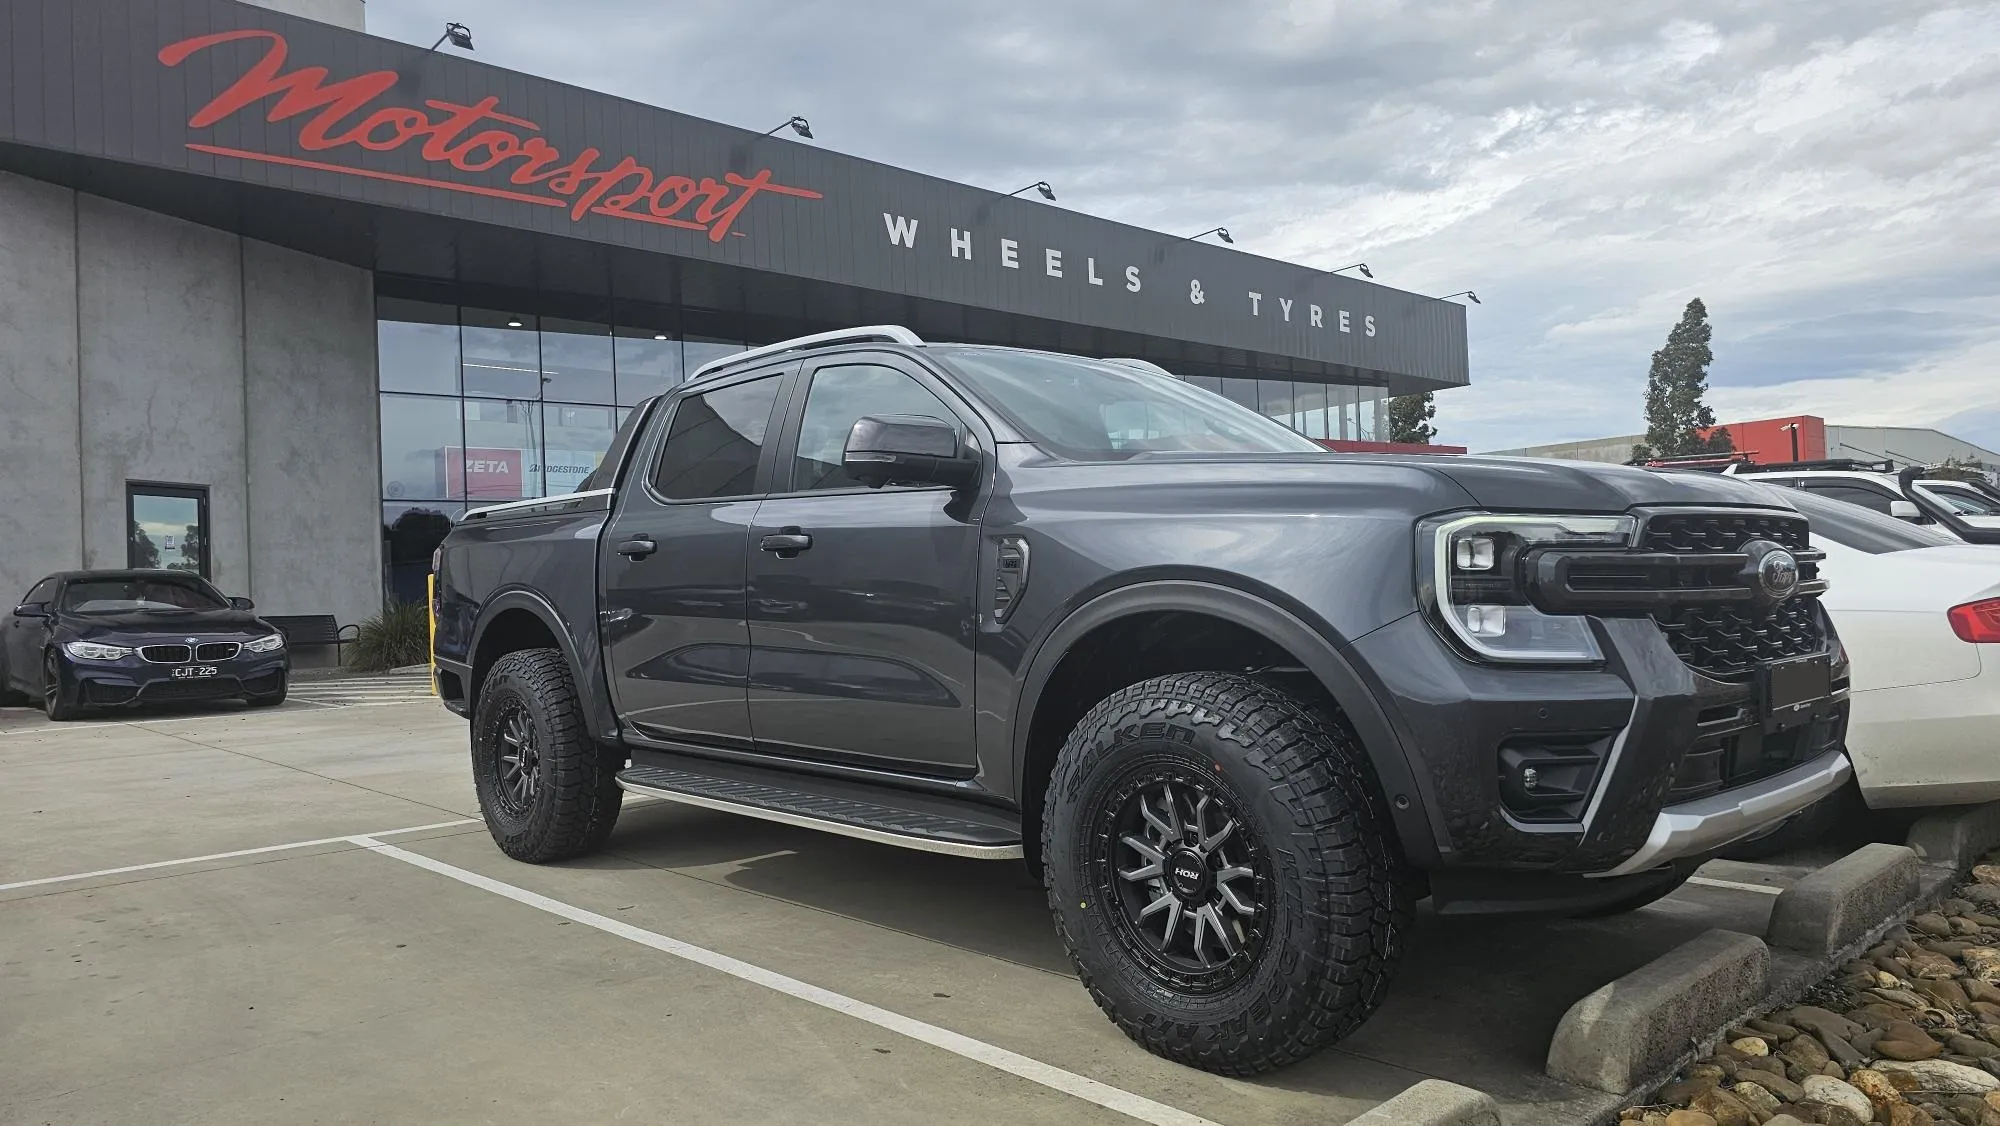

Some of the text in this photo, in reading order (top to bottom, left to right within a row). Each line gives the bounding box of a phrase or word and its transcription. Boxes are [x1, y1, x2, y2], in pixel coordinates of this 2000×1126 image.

[158, 29, 823, 242] Motorsport
[883, 212, 1377, 338] WHEELS & TYRES
[529, 464, 590, 474] BDGESTONE
[1174, 867, 1200, 880] ROH
